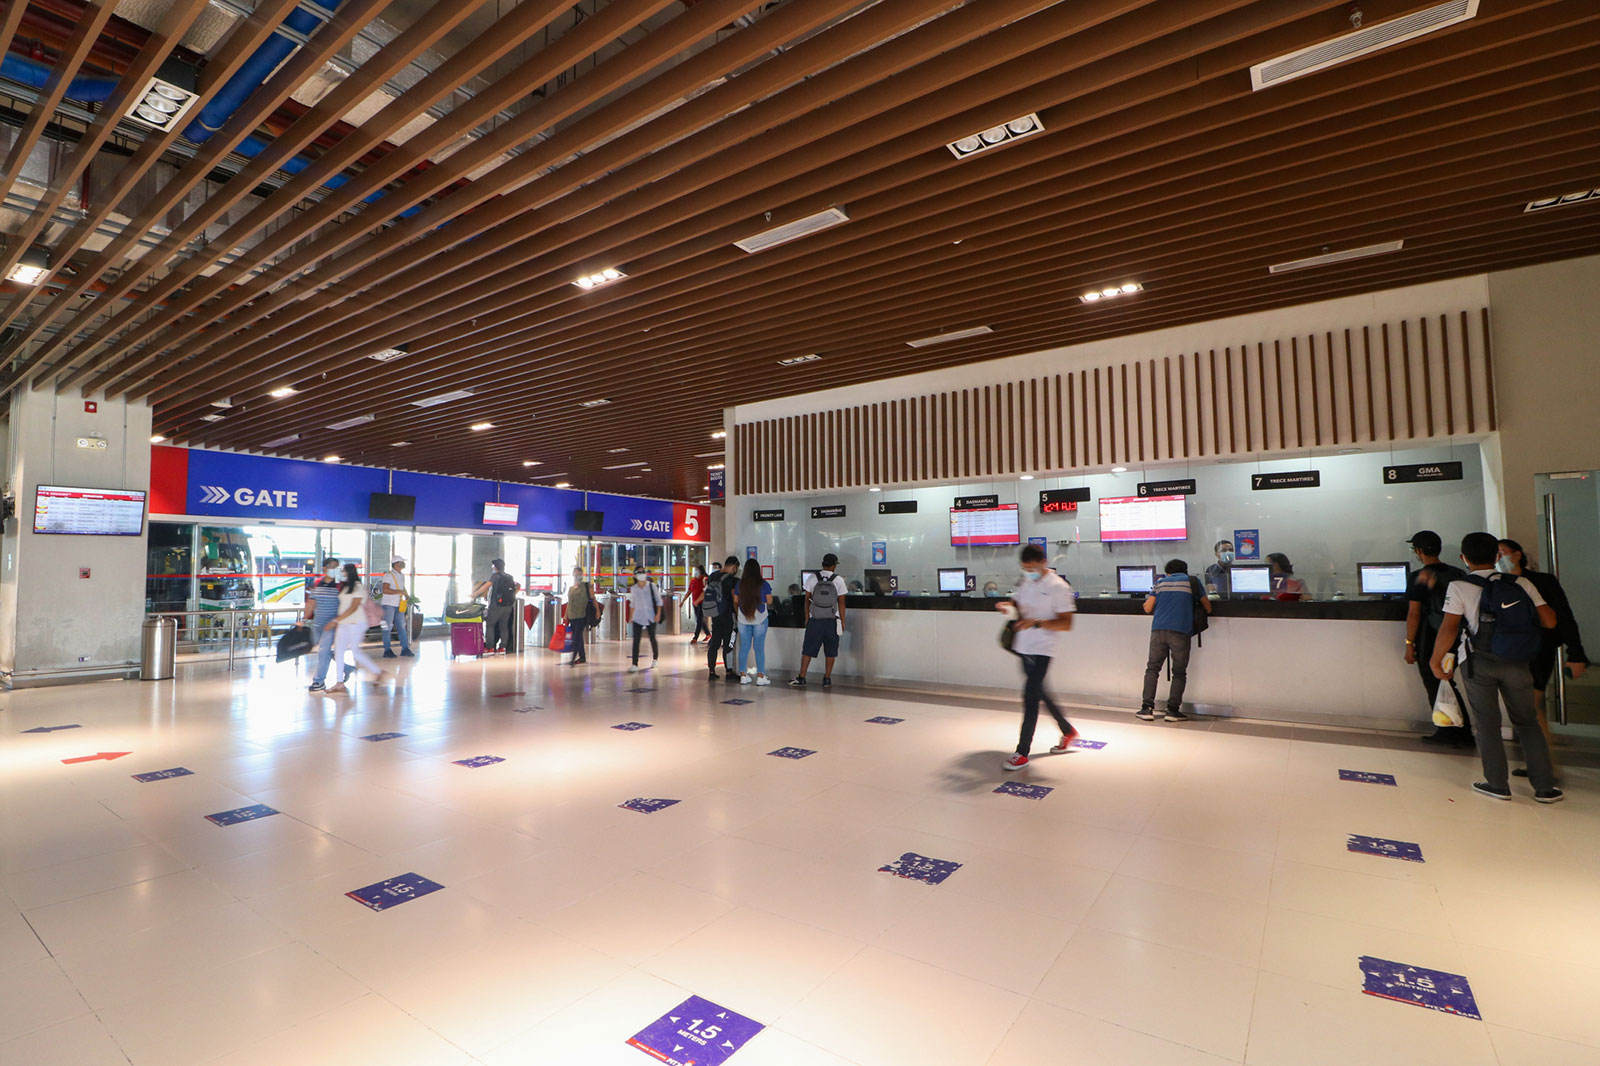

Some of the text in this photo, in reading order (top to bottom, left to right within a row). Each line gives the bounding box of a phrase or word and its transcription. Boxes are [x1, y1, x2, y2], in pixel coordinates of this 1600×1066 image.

[1387, 469, 1397, 480] 8
[1418, 466, 1441, 474] GMA
[717, 479, 723, 487] 4
[1255, 477, 1262, 487] 7
[1139, 486, 1147, 495] 6
[233, 487, 298, 508] GATE
[1041, 493, 1048, 502] 5
[880, 504, 886, 512] 3
[956, 499, 962, 507] 4
[813, 509, 818, 517] 2
[643, 519, 670, 533] GATE
[683, 508, 699, 537] 5
[890, 578, 897, 587] 3
[967, 578, 974, 588] 4
[1273, 577, 1284, 589] 7
[391, 882, 415, 894] 1.5
[1392, 972, 1436, 989] 1.5
[1394, 981, 1438, 994] METERS
[686, 1018, 723, 1040] 1.5
[676, 1029, 708, 1046] METERS
